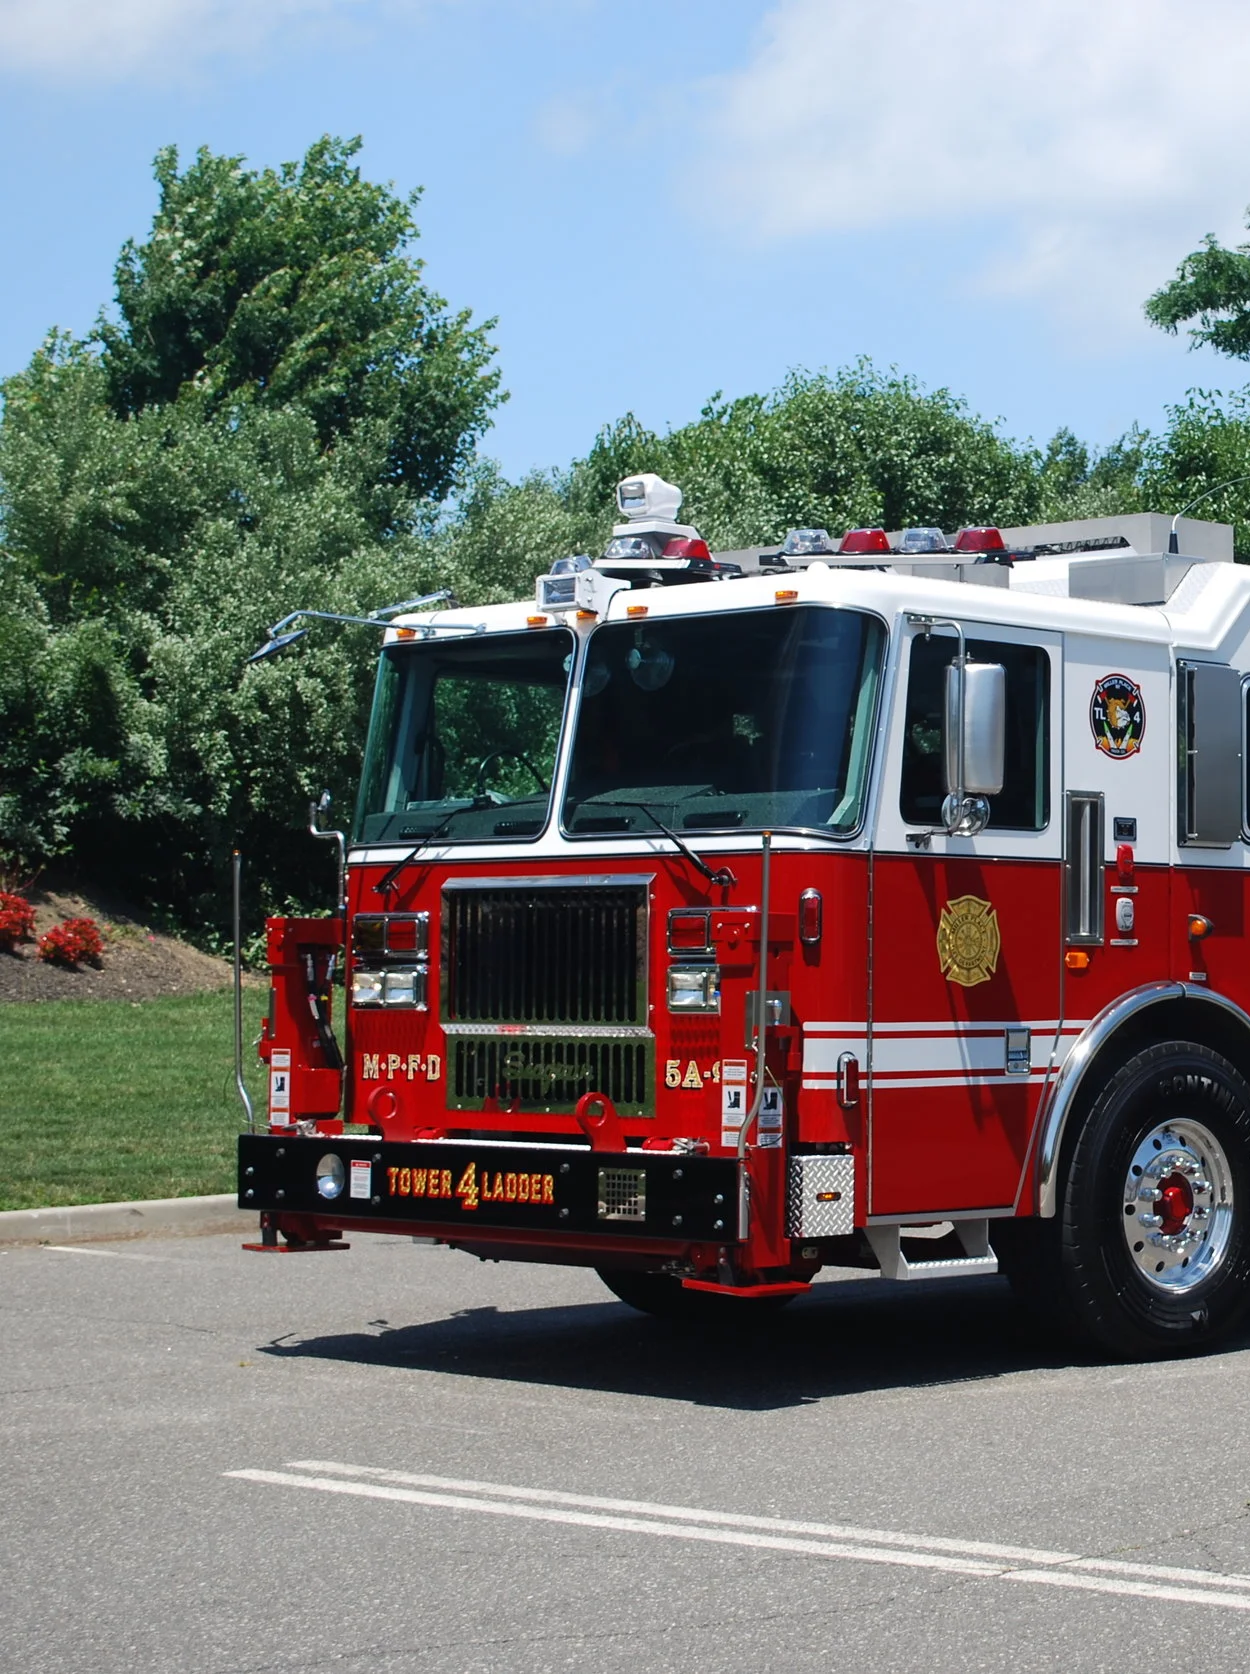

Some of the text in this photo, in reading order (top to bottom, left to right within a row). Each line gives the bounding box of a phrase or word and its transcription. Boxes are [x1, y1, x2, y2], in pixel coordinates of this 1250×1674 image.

[1094, 706, 1106, 720] TL
[1133, 711, 1141, 724] 4
[386, 1167, 452, 1198] TOWER
[456, 1161, 479, 1211] 4
[481, 1171, 555, 1205] LADDER
